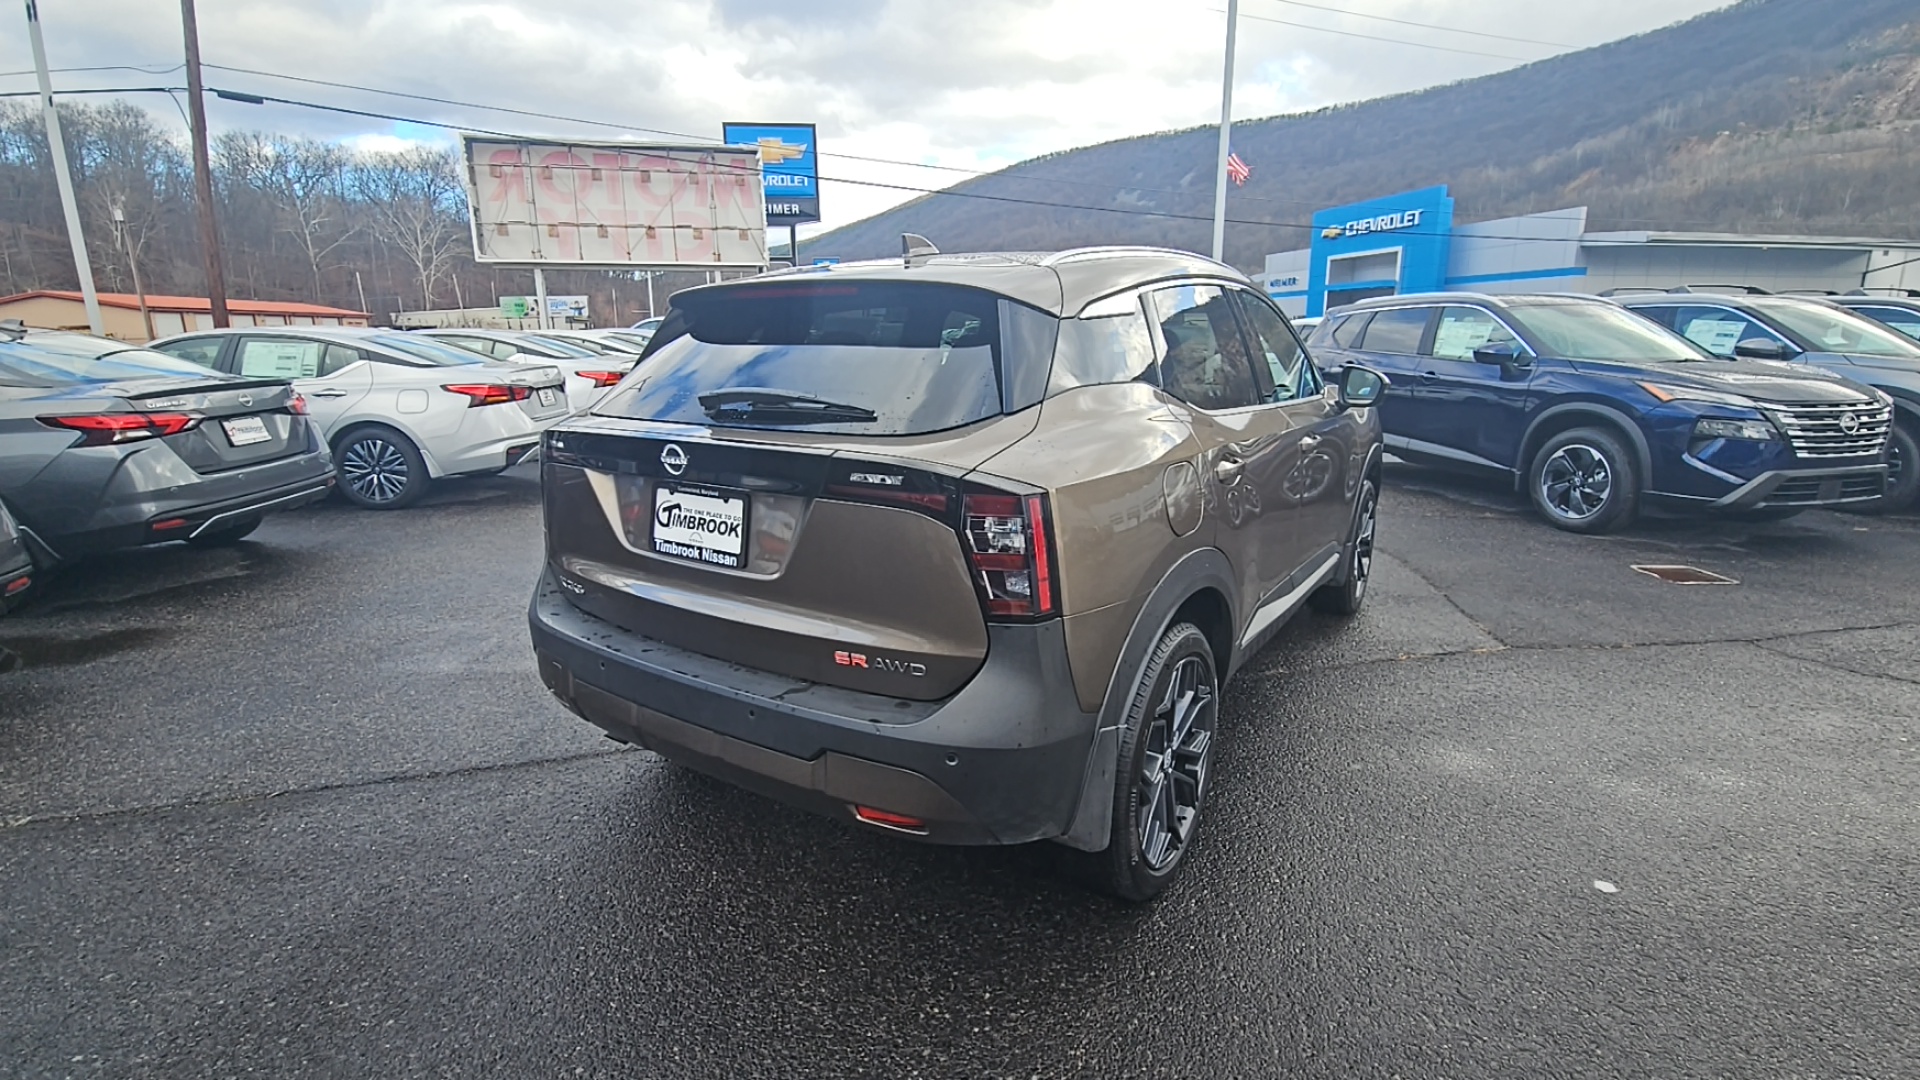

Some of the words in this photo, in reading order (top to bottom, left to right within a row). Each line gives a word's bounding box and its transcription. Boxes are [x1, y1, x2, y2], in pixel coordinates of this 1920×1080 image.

[1345, 210, 1424, 237] CHEVROLET
[657, 501, 741, 538] TIMBROOK
[706, 511, 723, 520] PLACE
[654, 538, 700, 559] Timbrook
[702, 548, 737, 566] Nissan
[834, 650, 869, 669] SR
[874, 657, 926, 676] AWD
